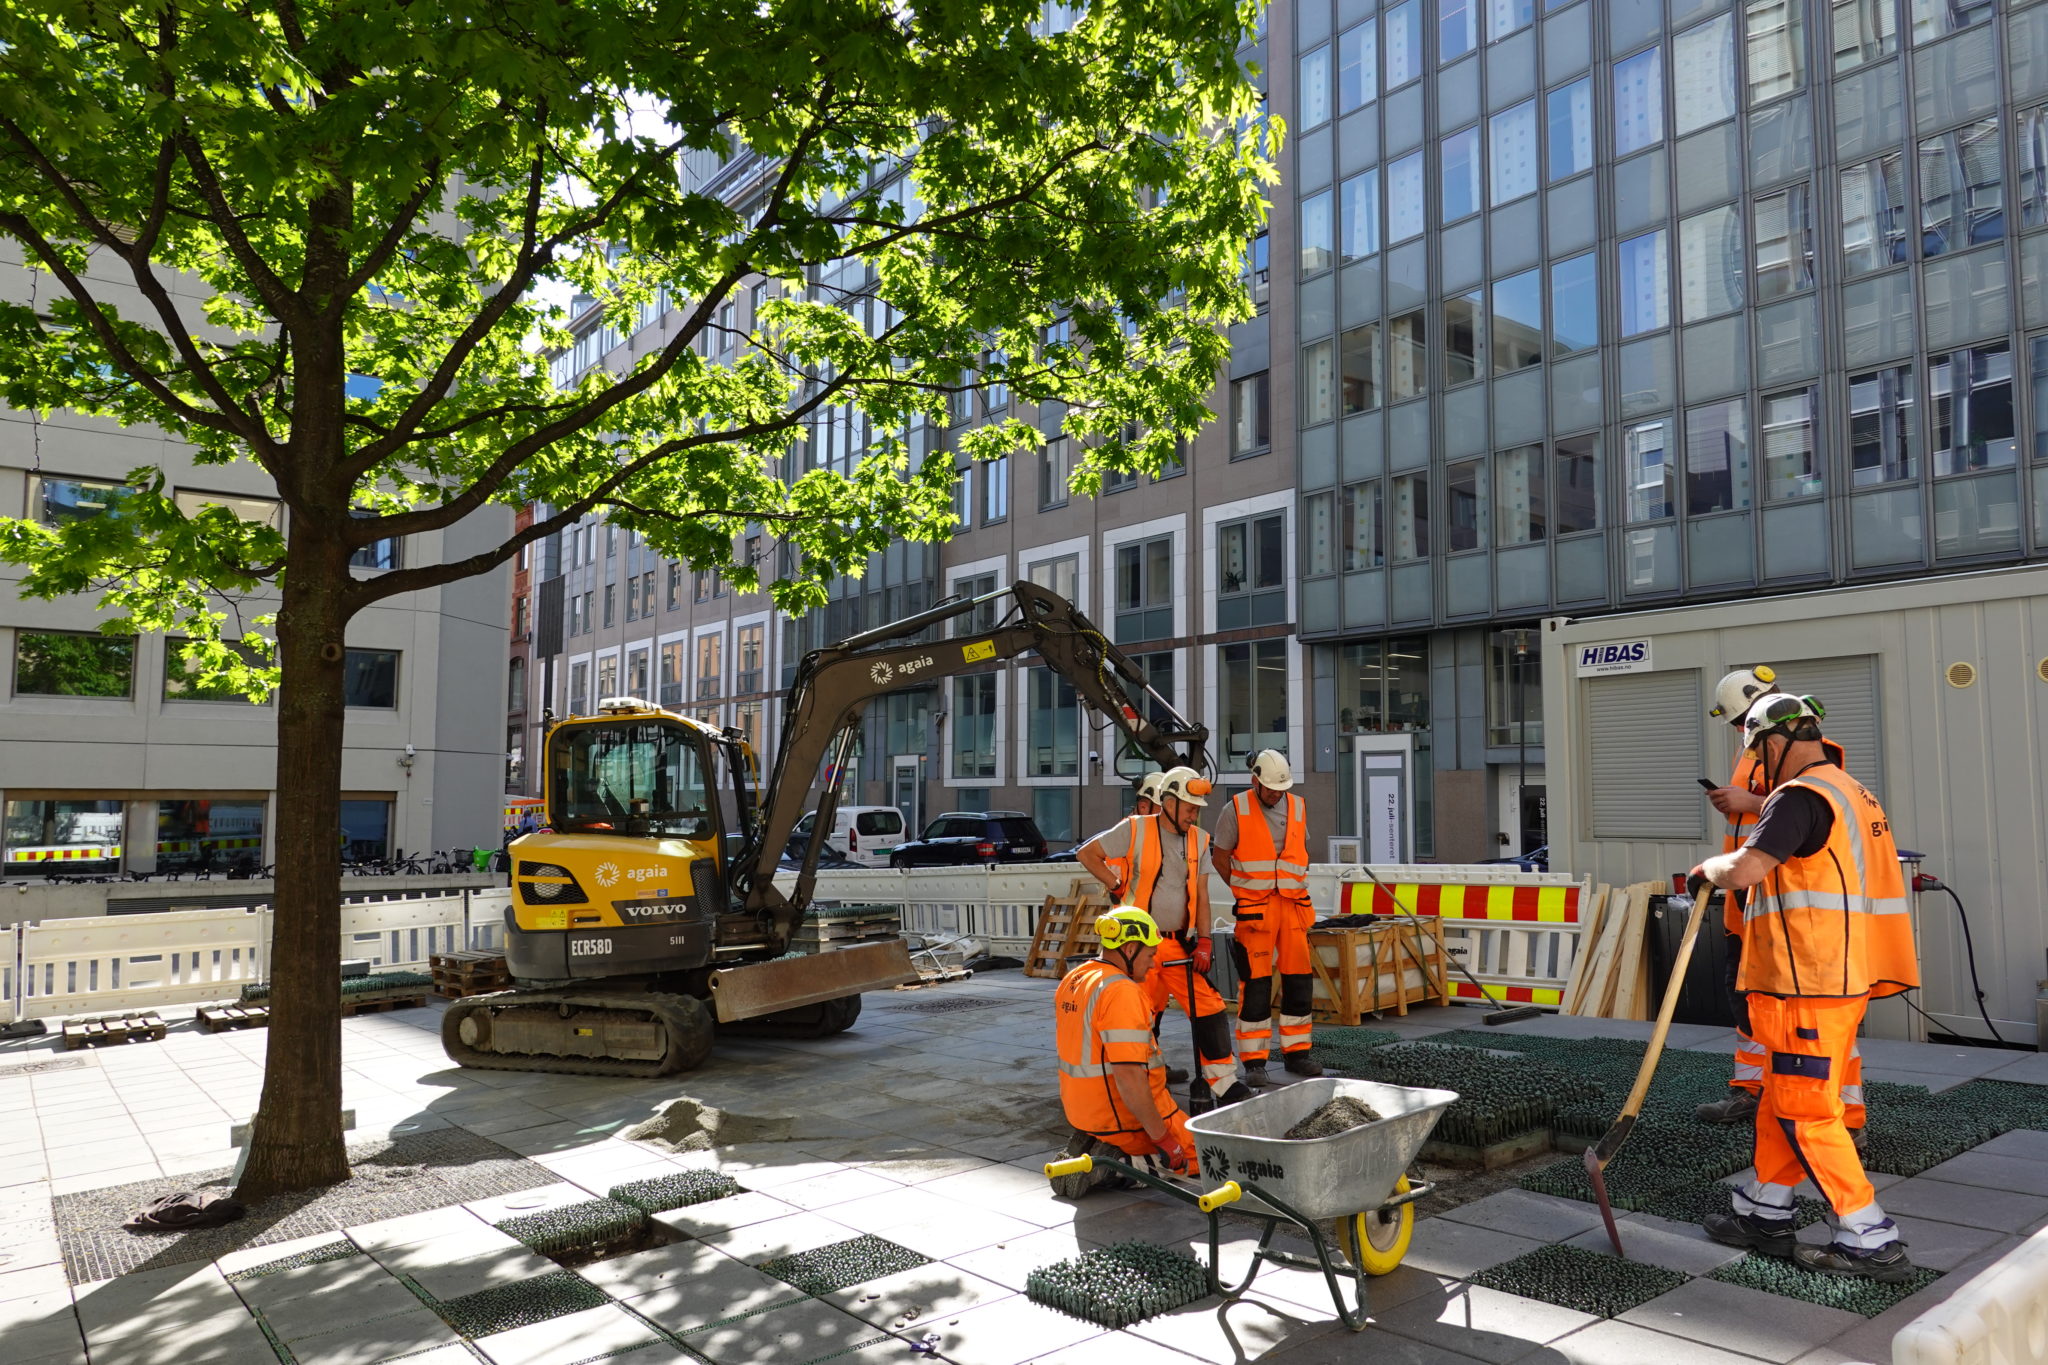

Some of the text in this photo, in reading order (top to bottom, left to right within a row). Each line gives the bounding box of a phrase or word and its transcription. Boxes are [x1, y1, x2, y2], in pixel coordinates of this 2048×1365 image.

[1582, 643, 1645, 665] HIBAS
[898, 655, 934, 674] agaia
[1387, 807, 1395, 860] juli-senteret
[627, 864, 668, 882] agaia
[625, 904, 687, 917] VOLVO
[571, 938, 613, 956] ECR58D
[1447, 946, 1468, 956] agaia
[1237, 1158, 1284, 1181] agaia
